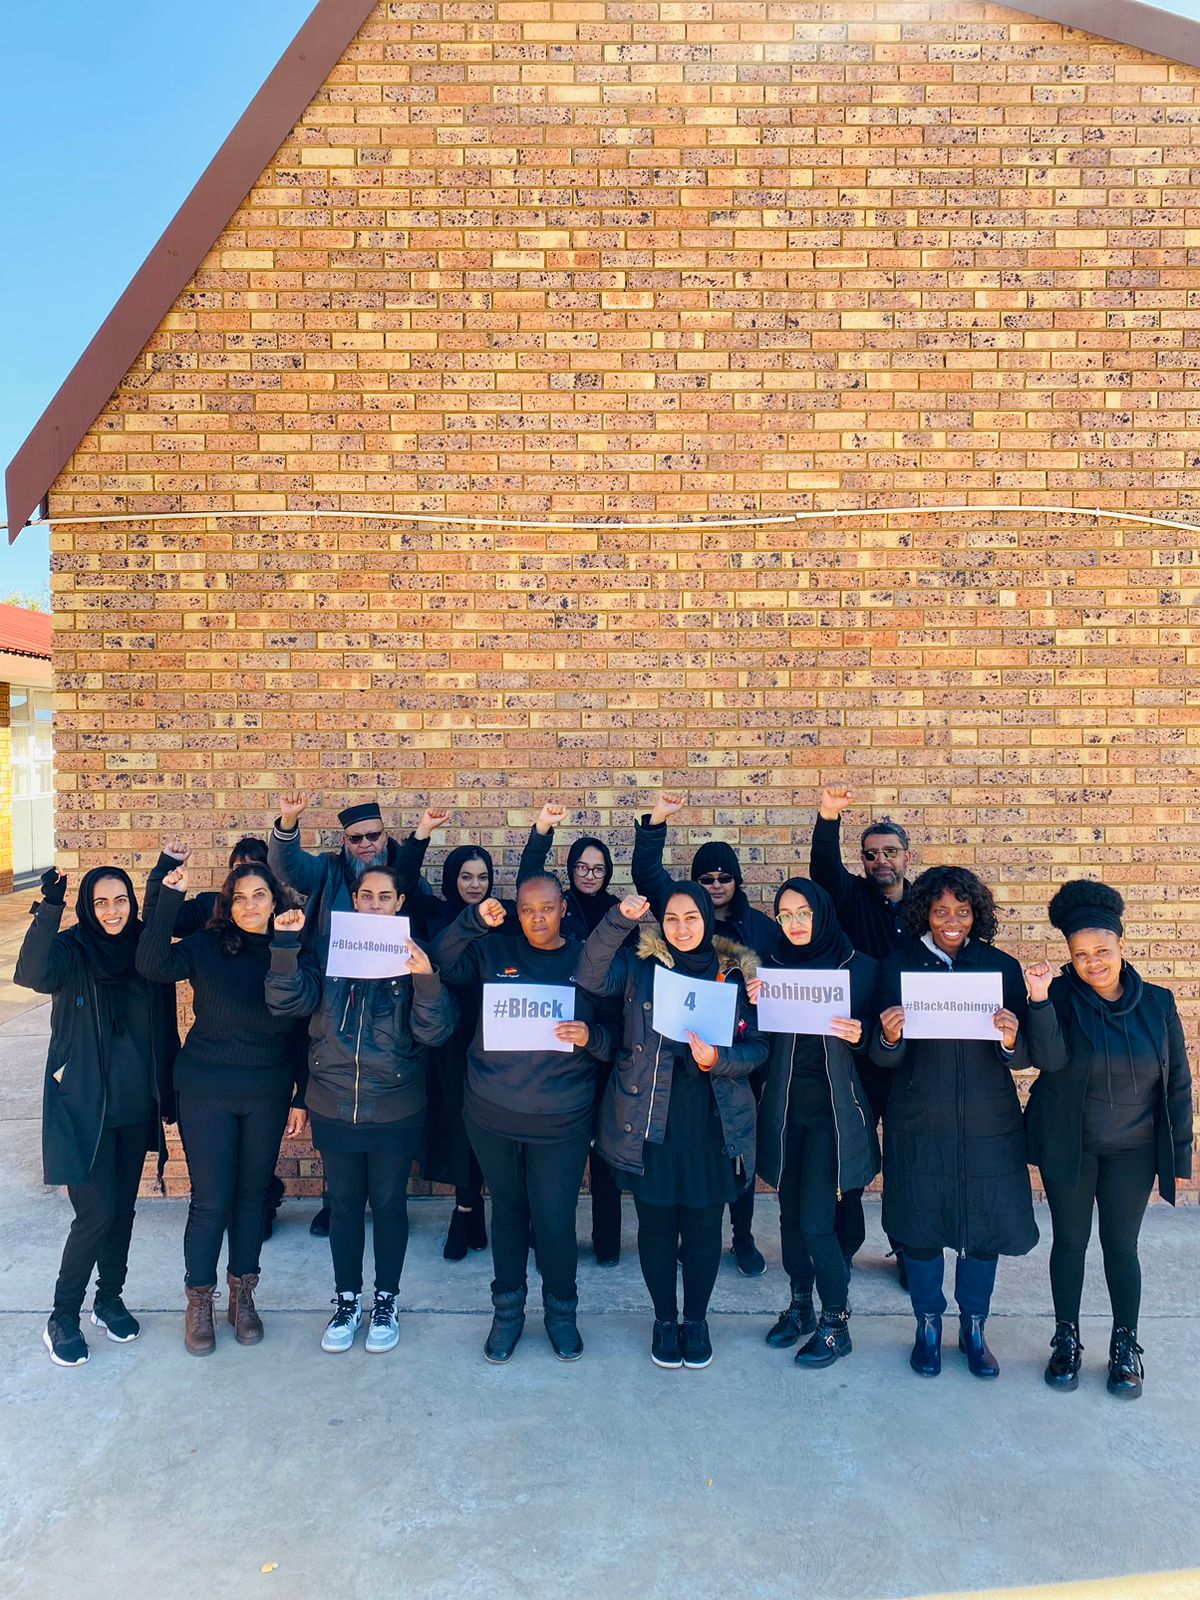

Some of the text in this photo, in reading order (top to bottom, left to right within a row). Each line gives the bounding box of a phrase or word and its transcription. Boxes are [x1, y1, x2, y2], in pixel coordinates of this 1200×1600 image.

[331, 939, 409, 954] #Black4Rohingya
[684, 991, 696, 1011] 4
[760, 981, 844, 1003] Rohingya
[493, 997, 563, 1018] #Black
[905, 1000, 1001, 1013] #Black4Rohingya
